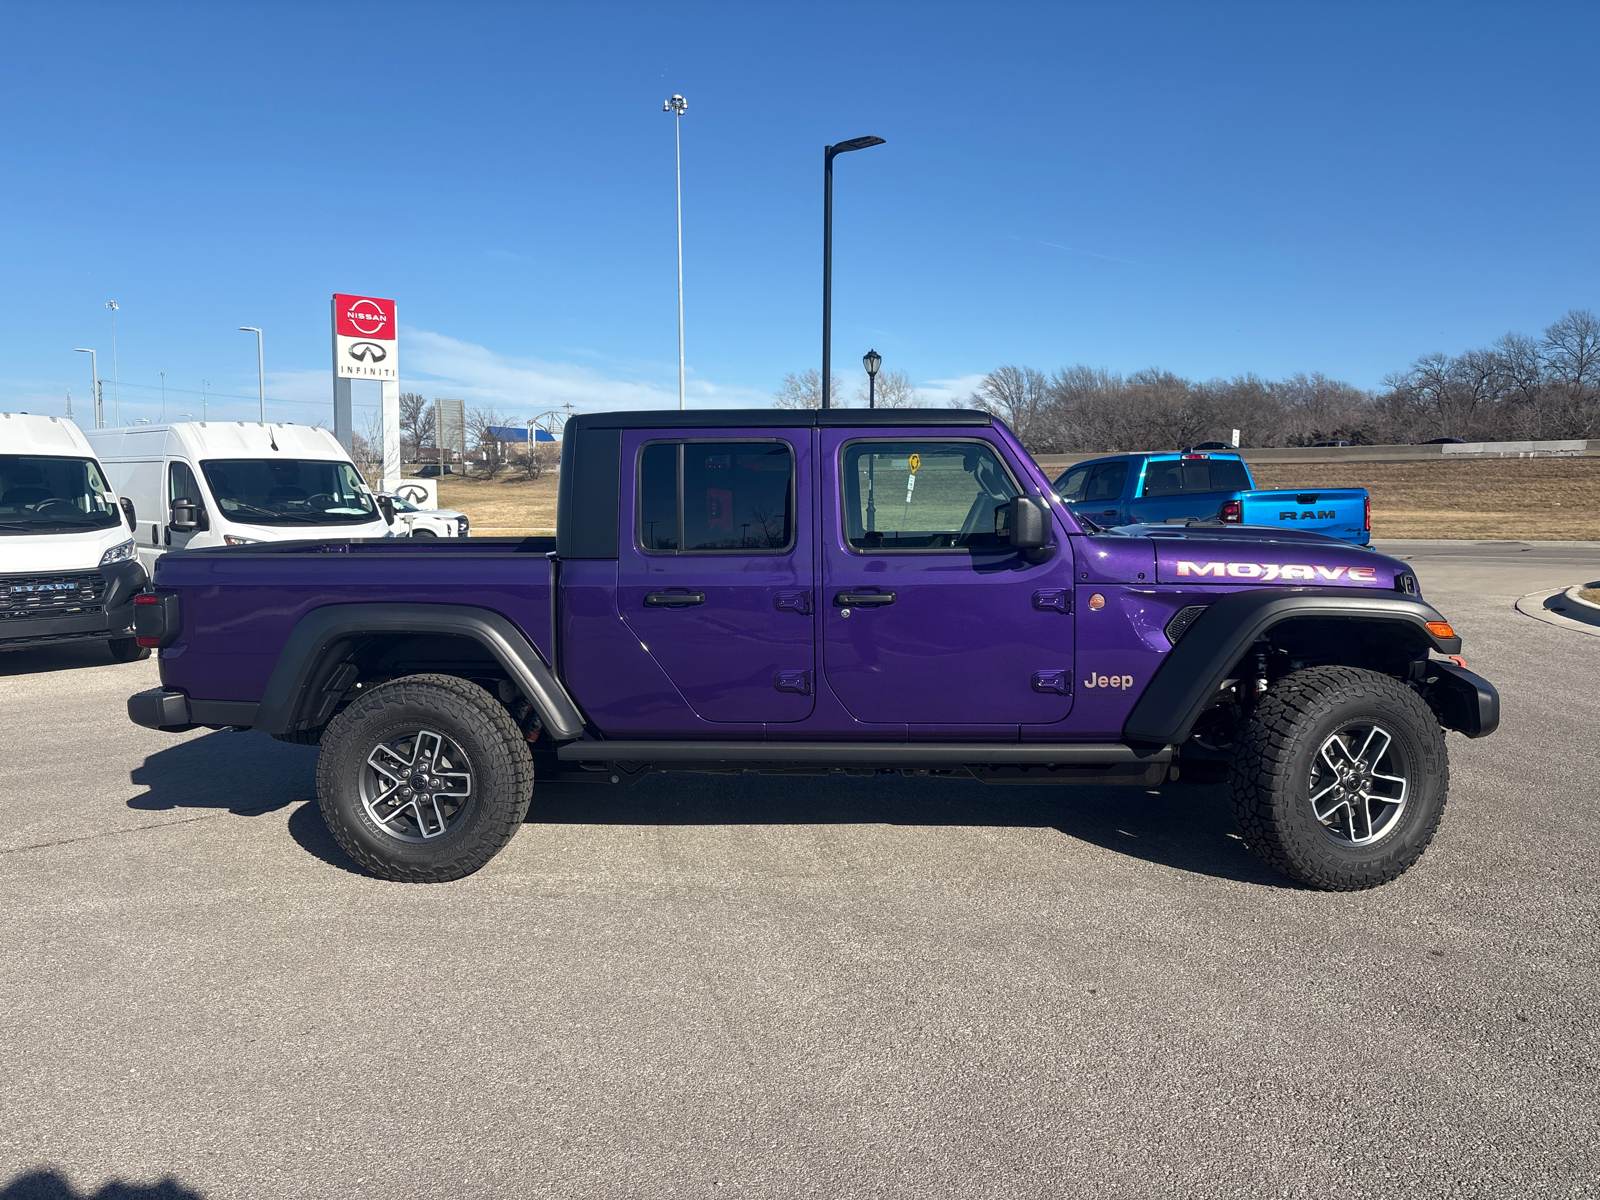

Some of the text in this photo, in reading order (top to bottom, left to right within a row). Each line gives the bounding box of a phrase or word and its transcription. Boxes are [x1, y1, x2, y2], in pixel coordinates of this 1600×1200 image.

[347, 311, 386, 322] NISSAN
[341, 365, 395, 377] INFINITI
[1279, 511, 1336, 521] RAM
[1176, 560, 1378, 582] MOJAVE
[13, 583, 75, 592] RAM
[1083, 671, 1134, 691] Jeep
